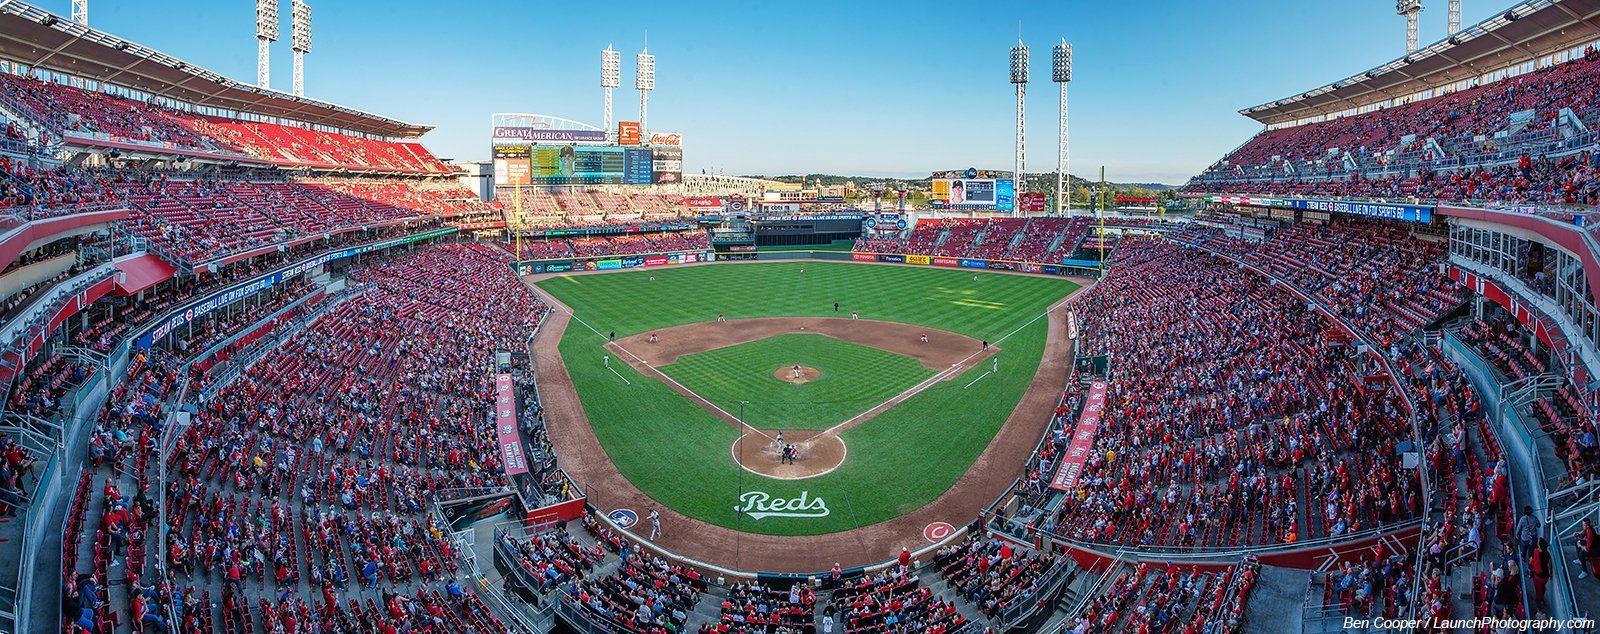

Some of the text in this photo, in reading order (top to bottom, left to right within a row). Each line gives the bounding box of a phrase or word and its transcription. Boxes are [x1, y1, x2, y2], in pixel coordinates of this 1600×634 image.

[496, 128, 527, 138] GREAT
[525, 130, 573, 141] AMERICAN
[1306, 201, 1319, 210] STREAM
[1334, 203, 1352, 213] BASEBALL
[1353, 204, 1362, 214] LIVE
[1362, 205, 1368, 215] ON
[1369, 205, 1378, 216] FOX
[1378, 206, 1396, 218] SPORTS
[1397, 208, 1404, 219] GO
[152, 279, 266, 343] STREAM REDS BASEBALL LIVE ON FOX SPORTS GO
[733, 490, 831, 521] Reds
